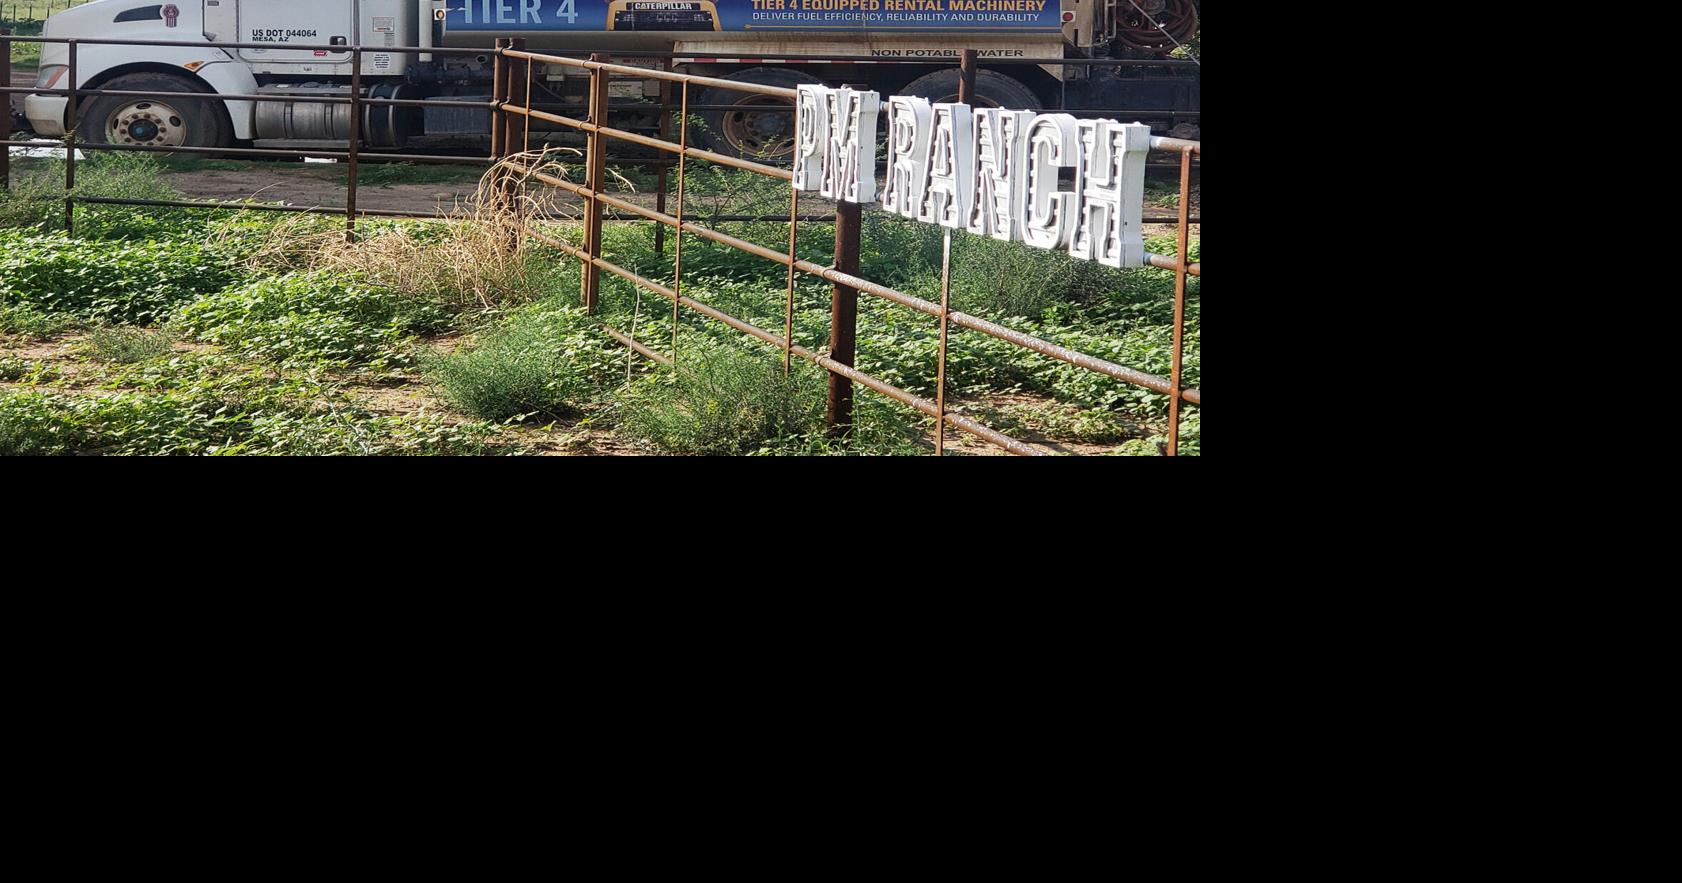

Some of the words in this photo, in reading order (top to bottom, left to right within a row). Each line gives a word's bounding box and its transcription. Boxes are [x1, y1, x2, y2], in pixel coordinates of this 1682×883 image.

[634, 2, 692, 10] CATERPILLAR
[751, 0, 785, 10] TIER
[789, 0, 798, 10] 4
[802, 0, 880, 11] EQUIPPED
[884, 0, 945, 11] RENTAL
[949, 0, 1046, 11] MACHINERY
[752, 12, 795, 20] DELIVER
[797, 12, 820, 20] FUEL
[824, 12, 884, 21] EFFICIENCY,
[886, 13, 948, 21] RELIABILITY
[951, 13, 974, 21] AND
[976, 13, 1040, 21] DURABILITY
[252, 29, 264, 37] US
[266, 29, 284, 37] DOT
[286, 29, 317, 37] 044064
[871, 49, 901, 57] NON
[905, 49, 962, 57] POTABL
[975, 49, 1024, 57] WATER
[792, 83, 879, 203] PM
[883, 95, 1151, 268] RANCH
